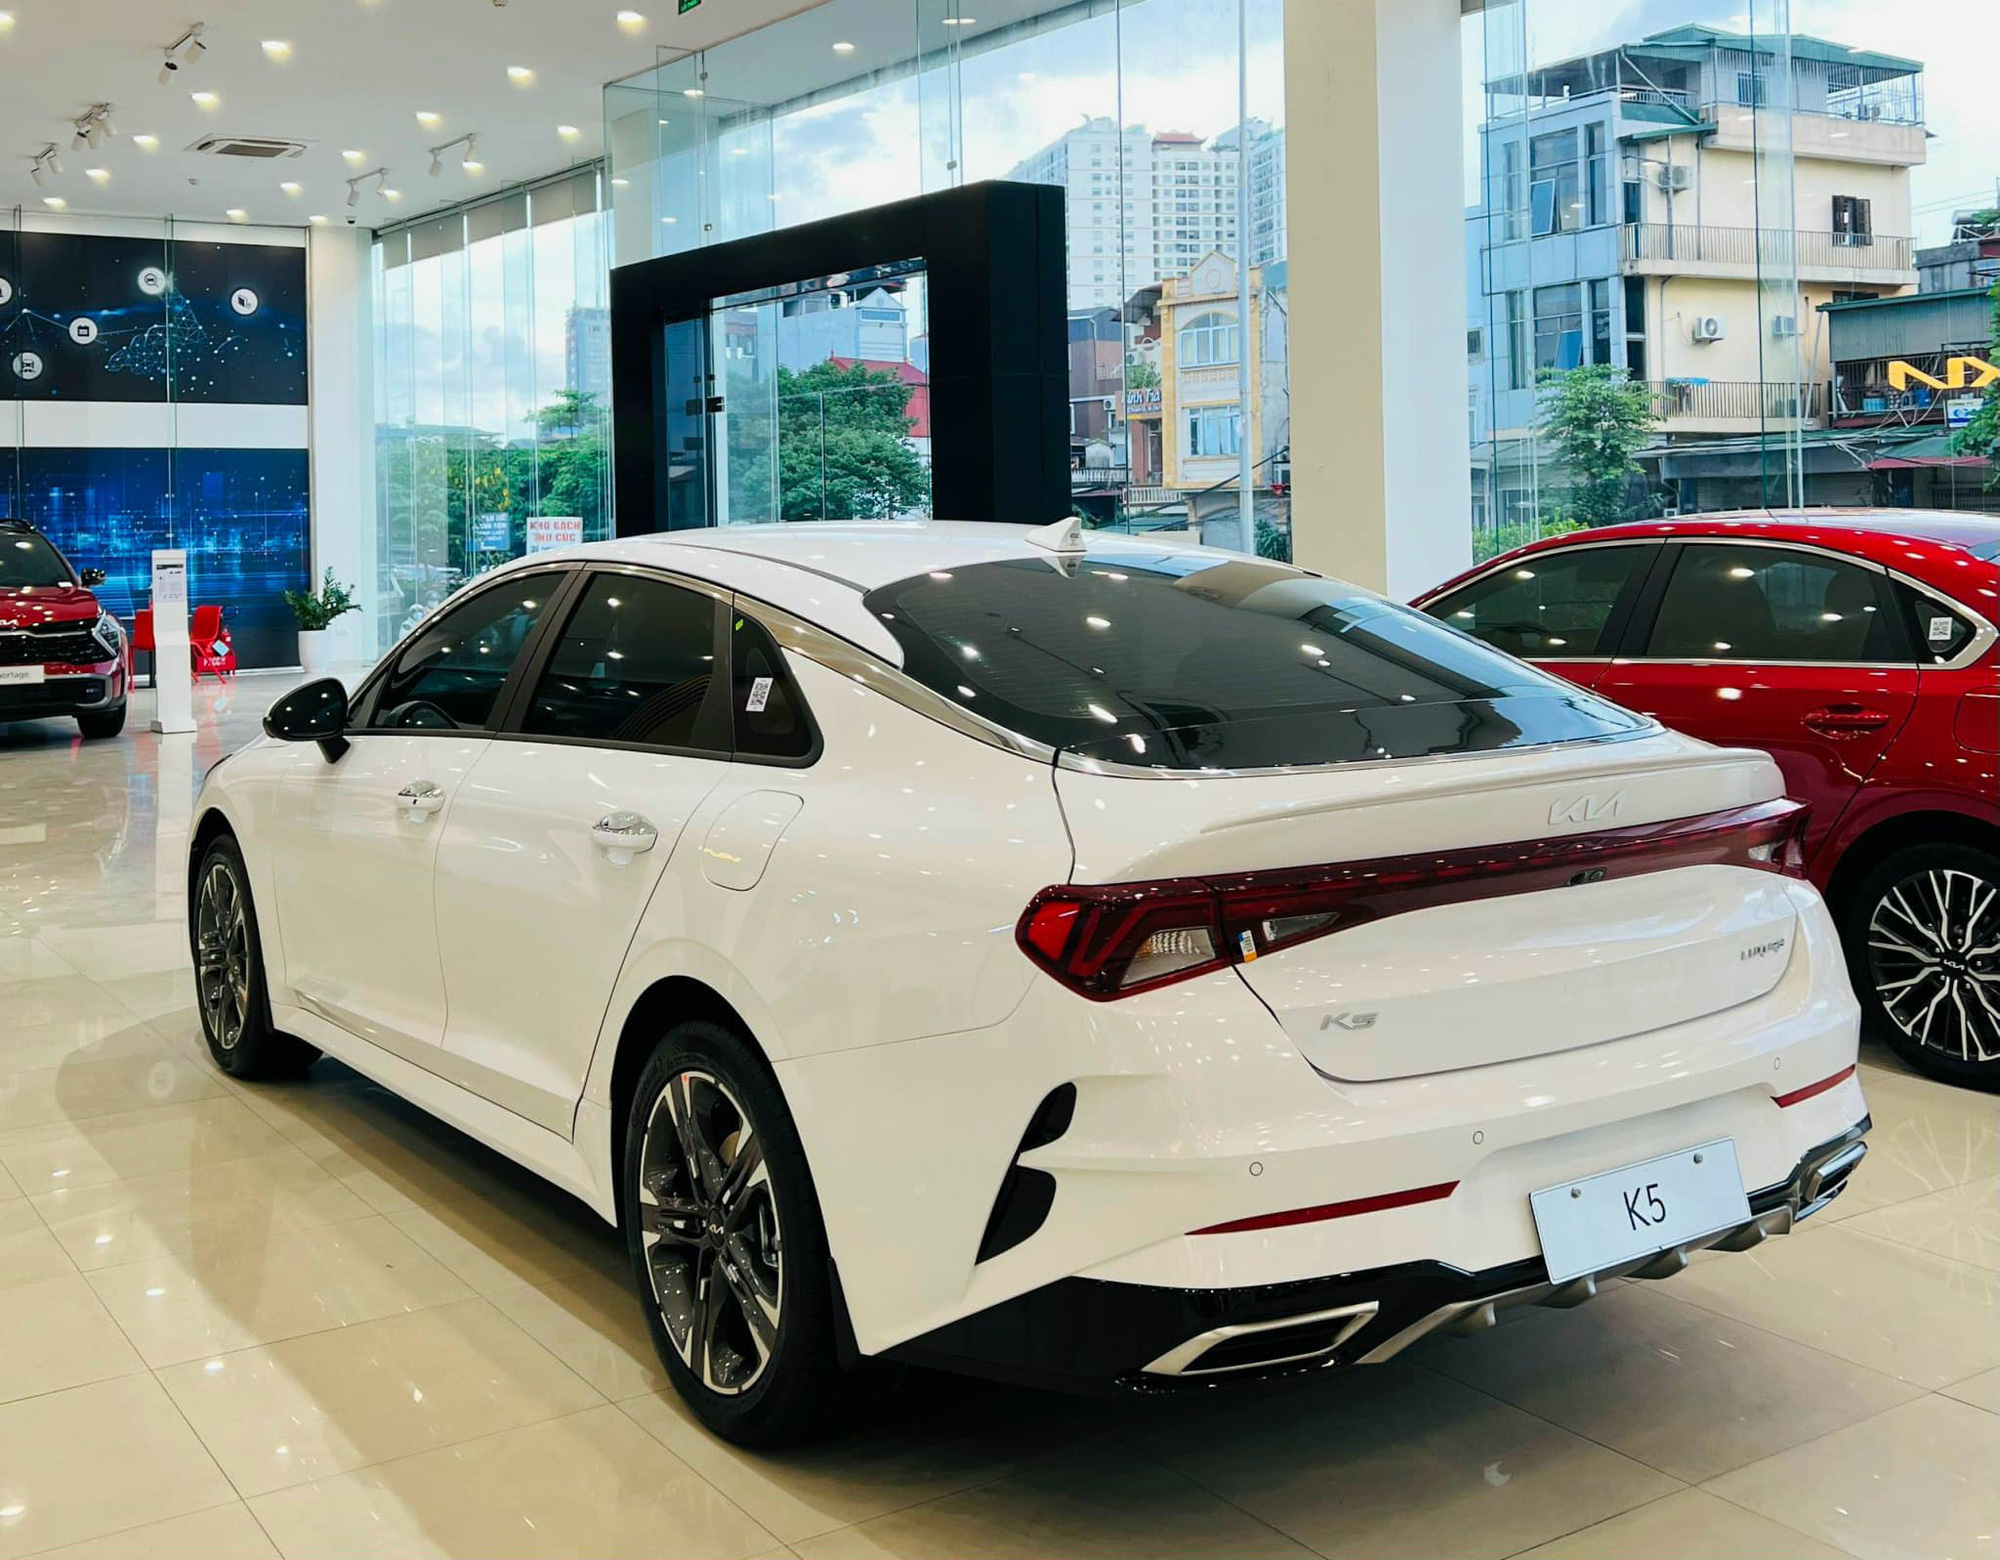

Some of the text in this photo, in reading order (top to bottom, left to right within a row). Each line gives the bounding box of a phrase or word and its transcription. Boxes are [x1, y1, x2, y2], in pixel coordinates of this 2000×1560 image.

[1548, 790, 1625, 825] KIA
[1320, 1012, 1380, 1031] K5
[1622, 1183, 1667, 1231] K5
